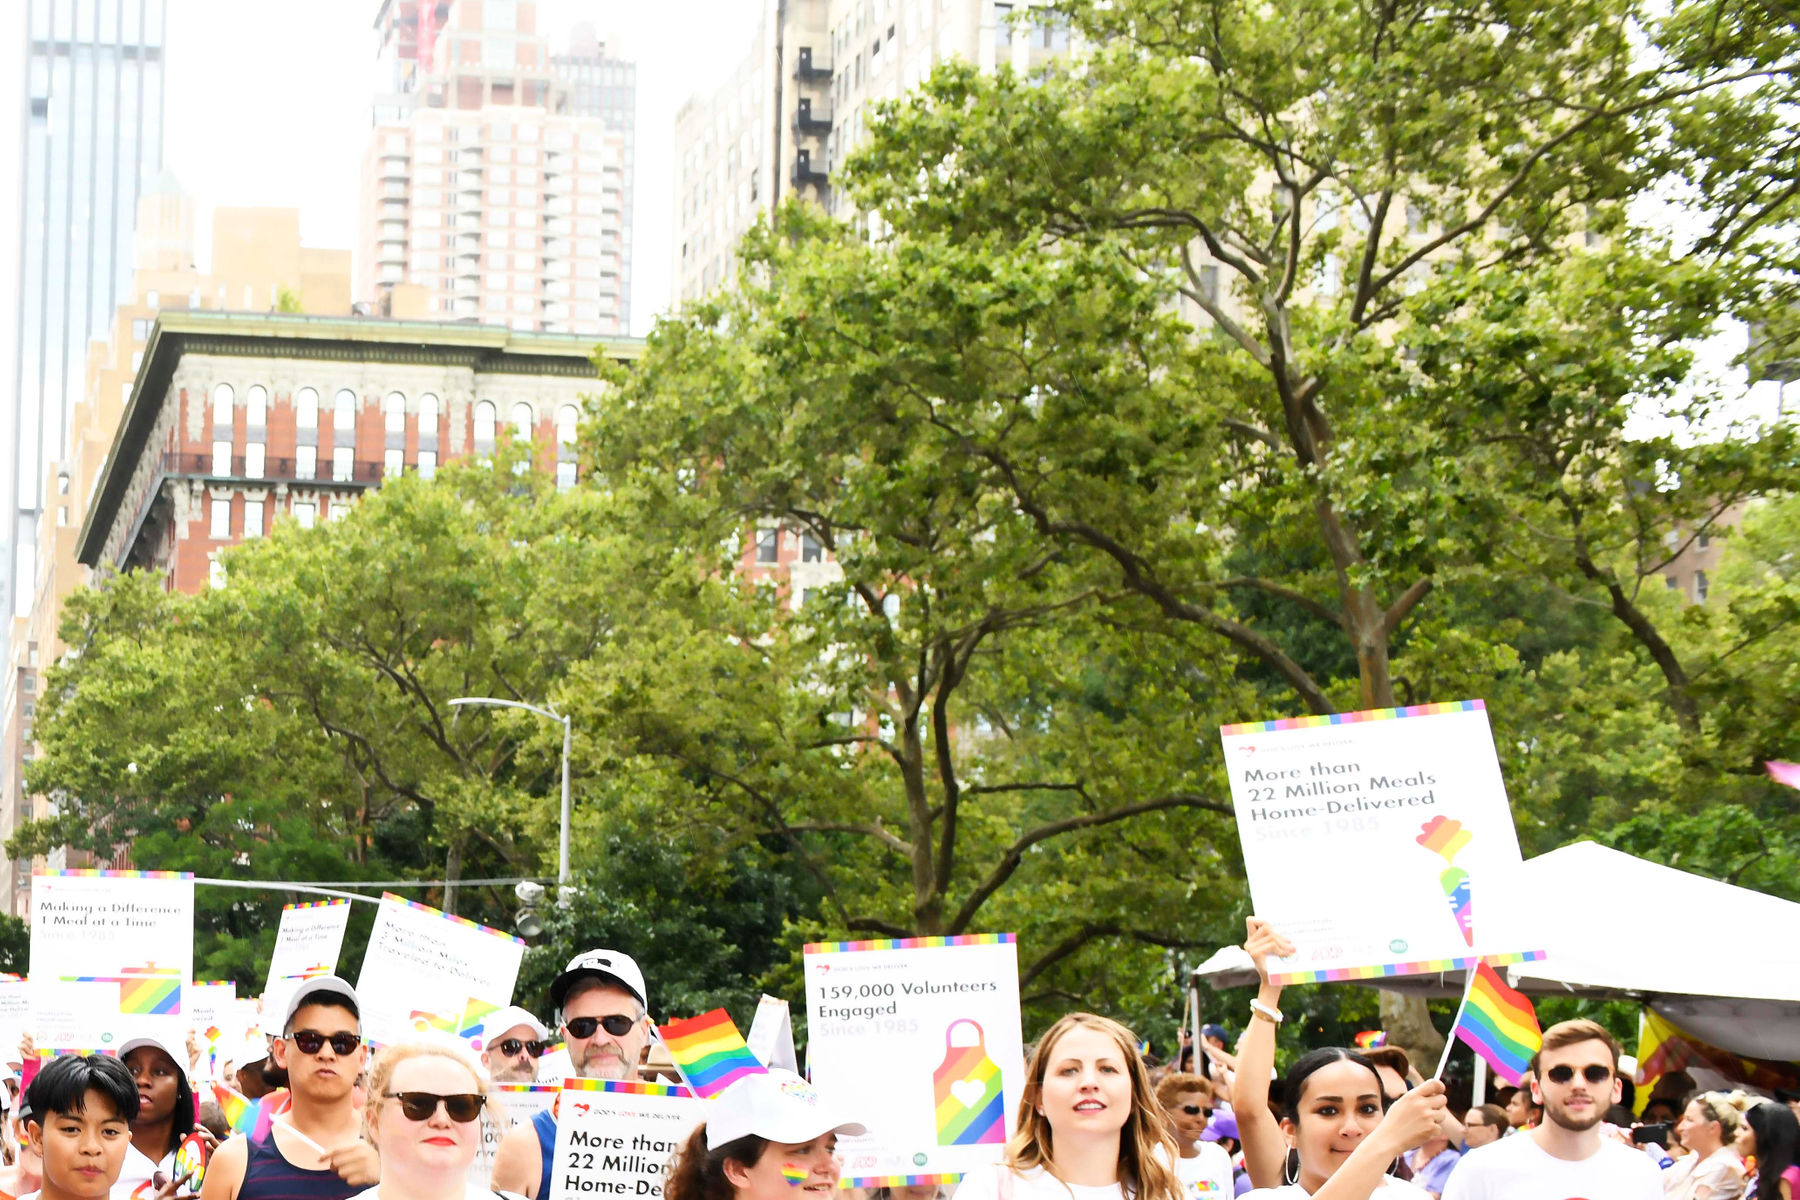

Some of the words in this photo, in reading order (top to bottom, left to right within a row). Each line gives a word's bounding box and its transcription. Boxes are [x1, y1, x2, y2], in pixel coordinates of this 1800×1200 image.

[1244, 769, 1301, 783] More
[1310, 762, 1361, 776] than
[1248, 787, 1277, 802] 22
[1285, 781, 1360, 799] Million
[1370, 771, 1436, 790] Meals
[1251, 790, 1436, 821] Home-Delivered
[40, 902, 93, 914] Making
[112, 904, 181, 914] Difference
[54, 915, 87, 925] Meal
[93, 917, 105, 925] at
[126, 917, 156, 927] Time
[819, 983, 895, 1000] 159,000
[902, 980, 997, 995] Volunteers
[819, 1001, 897, 1021] Engaged
[874, 1019, 919, 1035] 1985
[569, 1131, 624, 1149] More
[569, 1152, 595, 1169] 22
